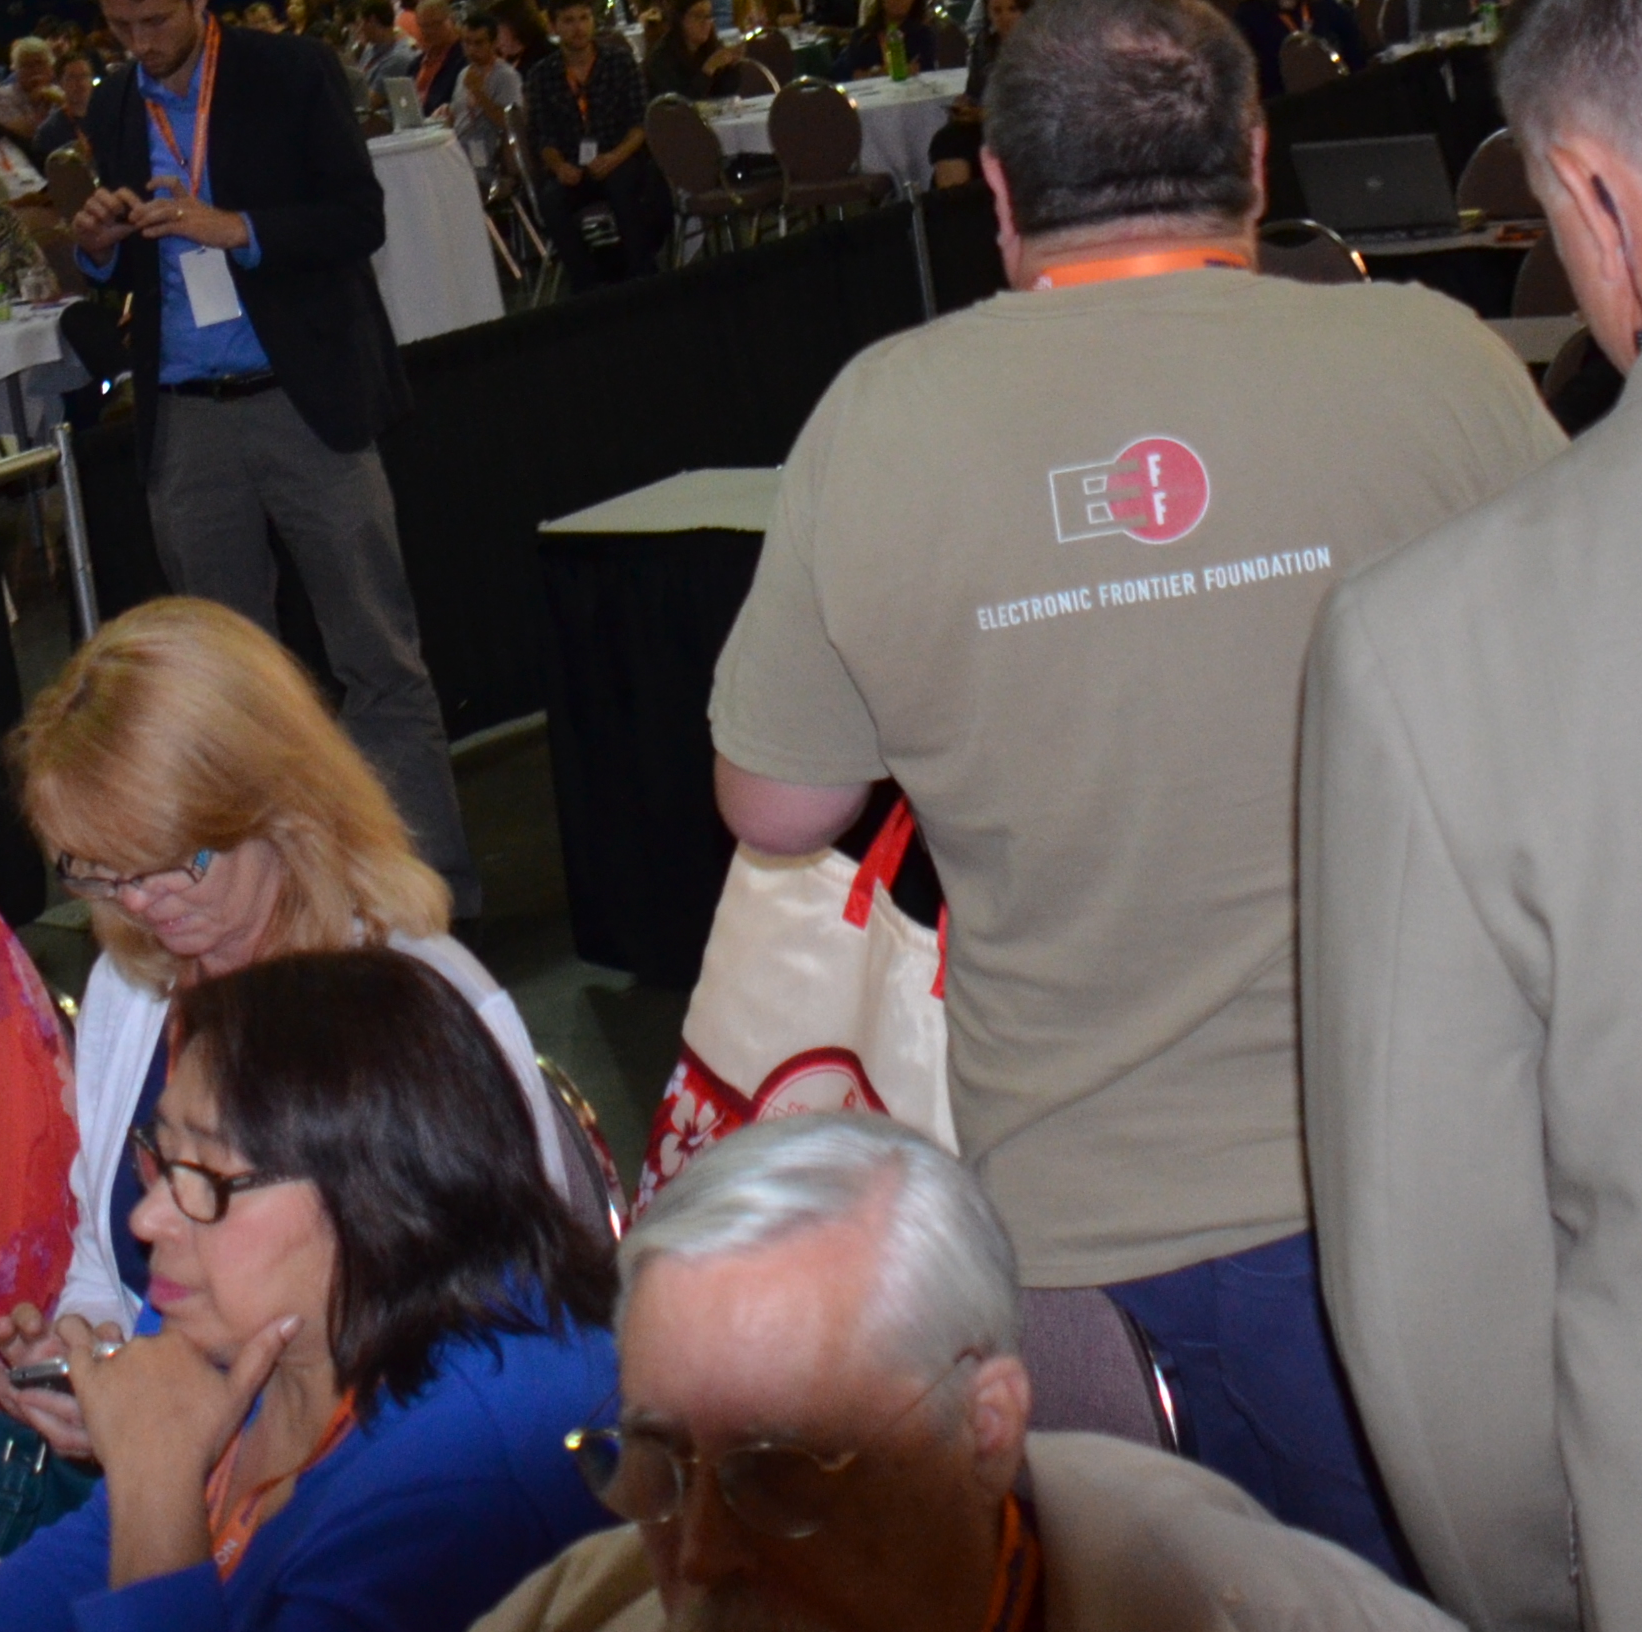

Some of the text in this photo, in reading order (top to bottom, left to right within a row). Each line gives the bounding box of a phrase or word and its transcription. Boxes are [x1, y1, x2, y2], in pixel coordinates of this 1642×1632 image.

[976, 546, 1332, 630] ELECTRONIC FRONTIER FOUNDATION
